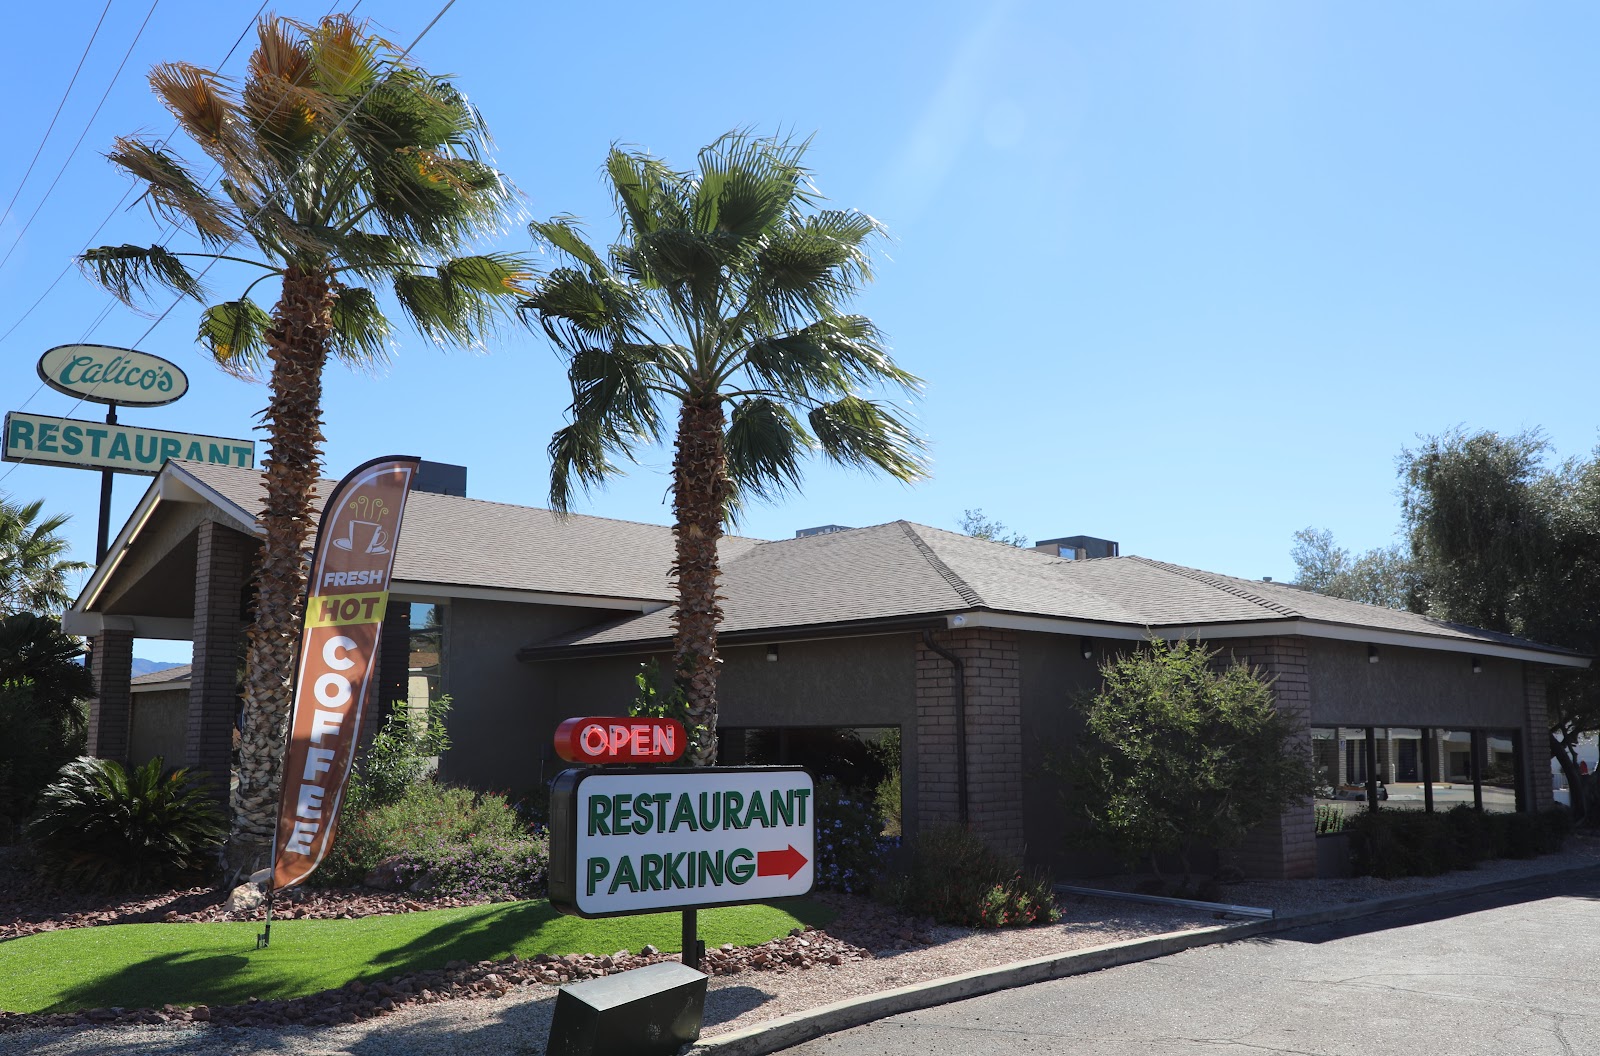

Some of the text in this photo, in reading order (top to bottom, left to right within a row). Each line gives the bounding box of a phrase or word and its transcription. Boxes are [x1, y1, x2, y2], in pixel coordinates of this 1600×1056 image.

[59, 355, 173, 392] Calico's
[9, 419, 252, 467] RESTAURANT
[323, 570, 383, 588] FRESH
[318, 597, 380, 622] HOT
[286, 635, 358, 856] COFFEE
[580, 724, 675, 756] OPEN
[588, 788, 811, 836] RESTAURANT
[586, 848, 756, 896] PARKING
